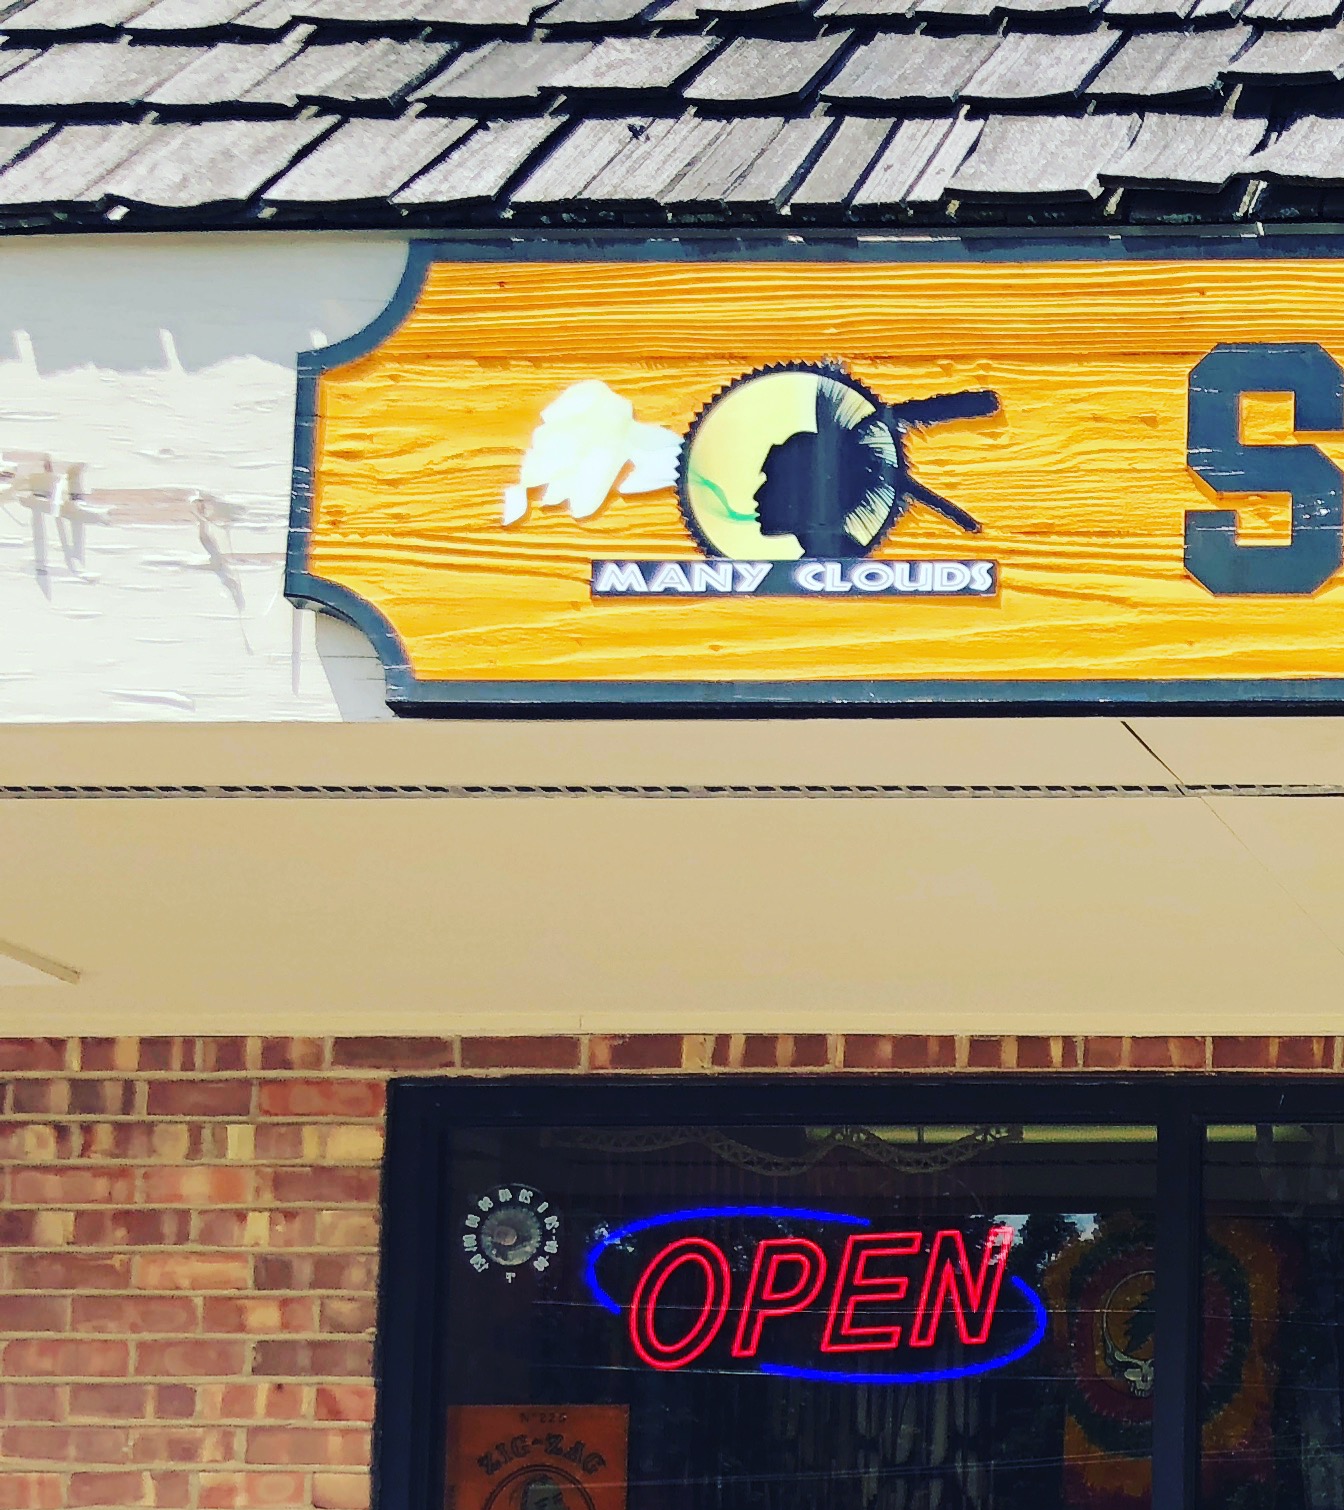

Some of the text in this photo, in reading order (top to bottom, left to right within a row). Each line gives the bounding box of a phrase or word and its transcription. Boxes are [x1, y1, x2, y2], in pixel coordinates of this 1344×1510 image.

[596, 561, 994, 592] MANY CLOUDS
[629, 1226, 1014, 1370] OPEN
[477, 1433, 606, 1476] ZIG-ZAG
